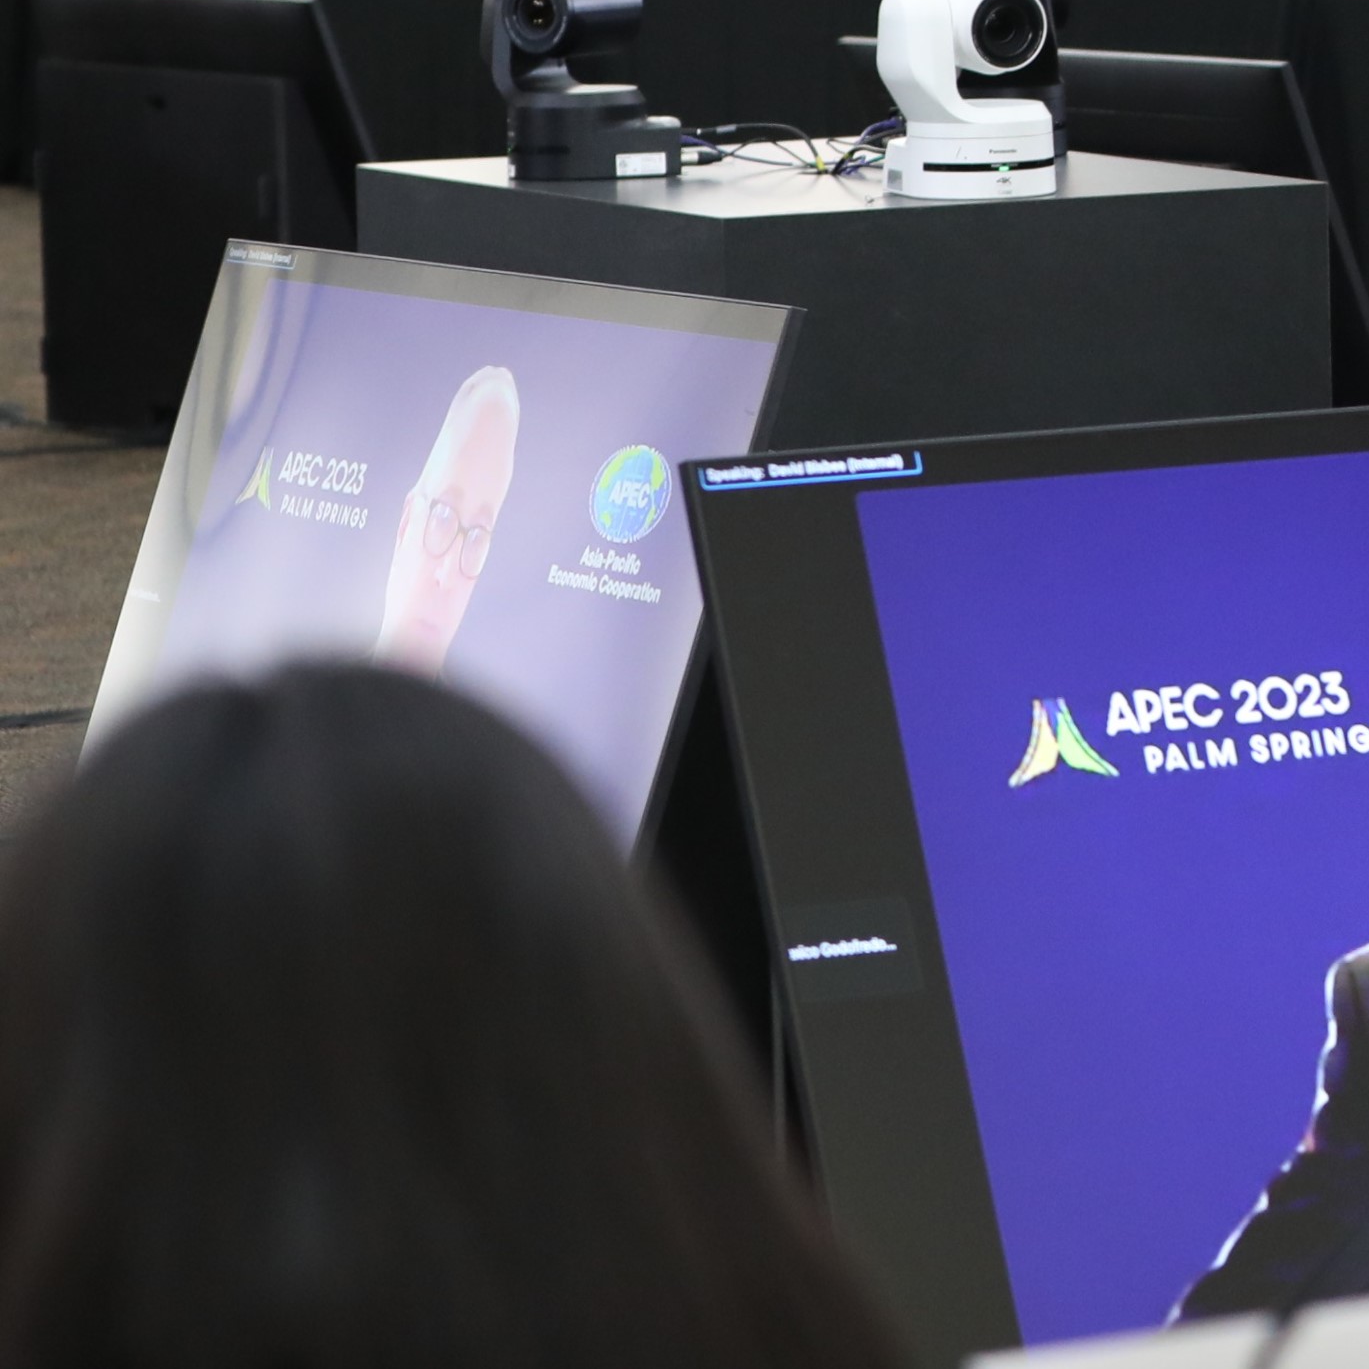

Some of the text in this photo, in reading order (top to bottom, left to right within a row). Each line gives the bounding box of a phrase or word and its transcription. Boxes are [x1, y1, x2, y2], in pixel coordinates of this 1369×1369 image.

[278, 451, 368, 496] APEC 2023
[280, 494, 368, 530] PALM SPRINGS
[608, 480, 650, 509] APEC
[579, 544, 641, 576] Asia-Pacific
[547, 564, 662, 604] Economic Cooperation
[1106, 670, 1351, 737] APEC 2023
[1143, 736, 1238, 774] PALM
